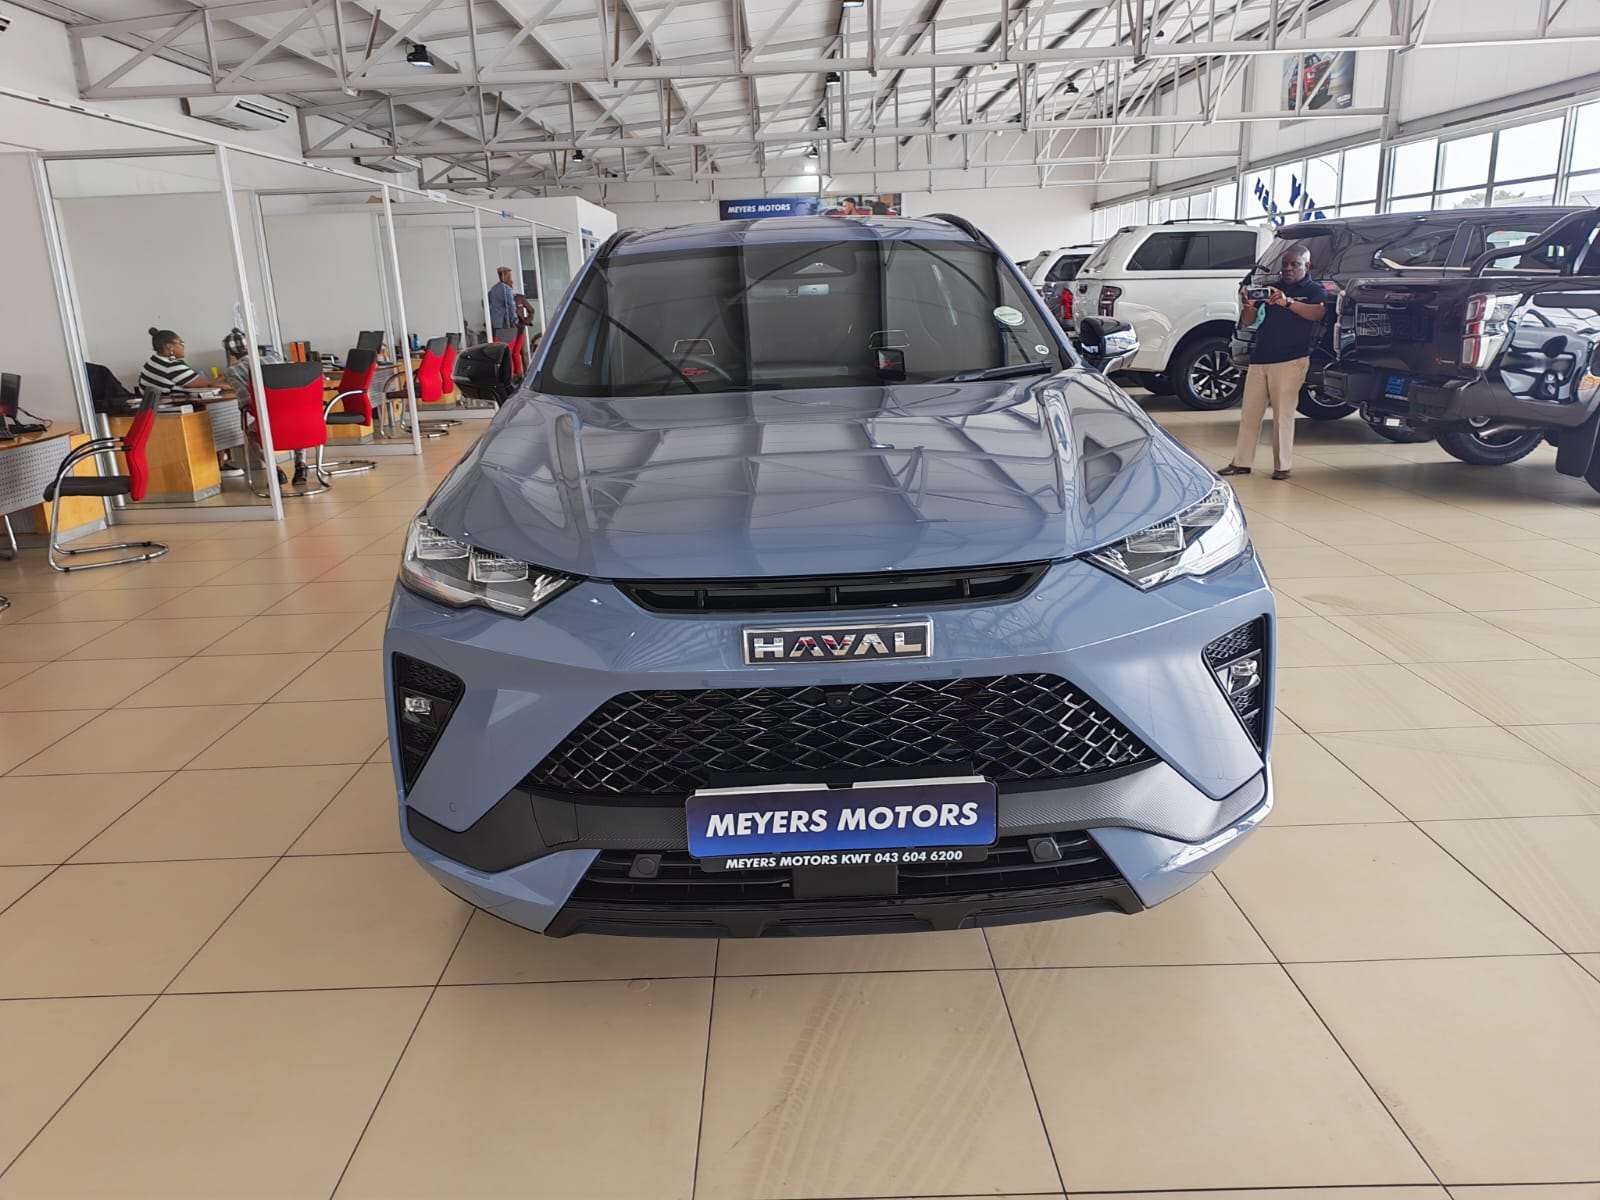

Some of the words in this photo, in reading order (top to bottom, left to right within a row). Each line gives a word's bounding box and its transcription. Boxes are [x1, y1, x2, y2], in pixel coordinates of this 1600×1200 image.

[728, 205, 756, 213] MEYERS
[758, 204, 791, 212] MOTORS
[753, 632, 922, 658] HAVAL
[706, 809, 828, 837] MEYERS
[837, 802, 979, 831] MOTORS
[725, 857, 776, 869] MEYERS
[780, 854, 838, 867] MOTORS
[841, 853, 872, 864] KWT
[874, 852, 899, 863] 043
[902, 851, 926, 862] 604
[930, 850, 963, 861] 6200
